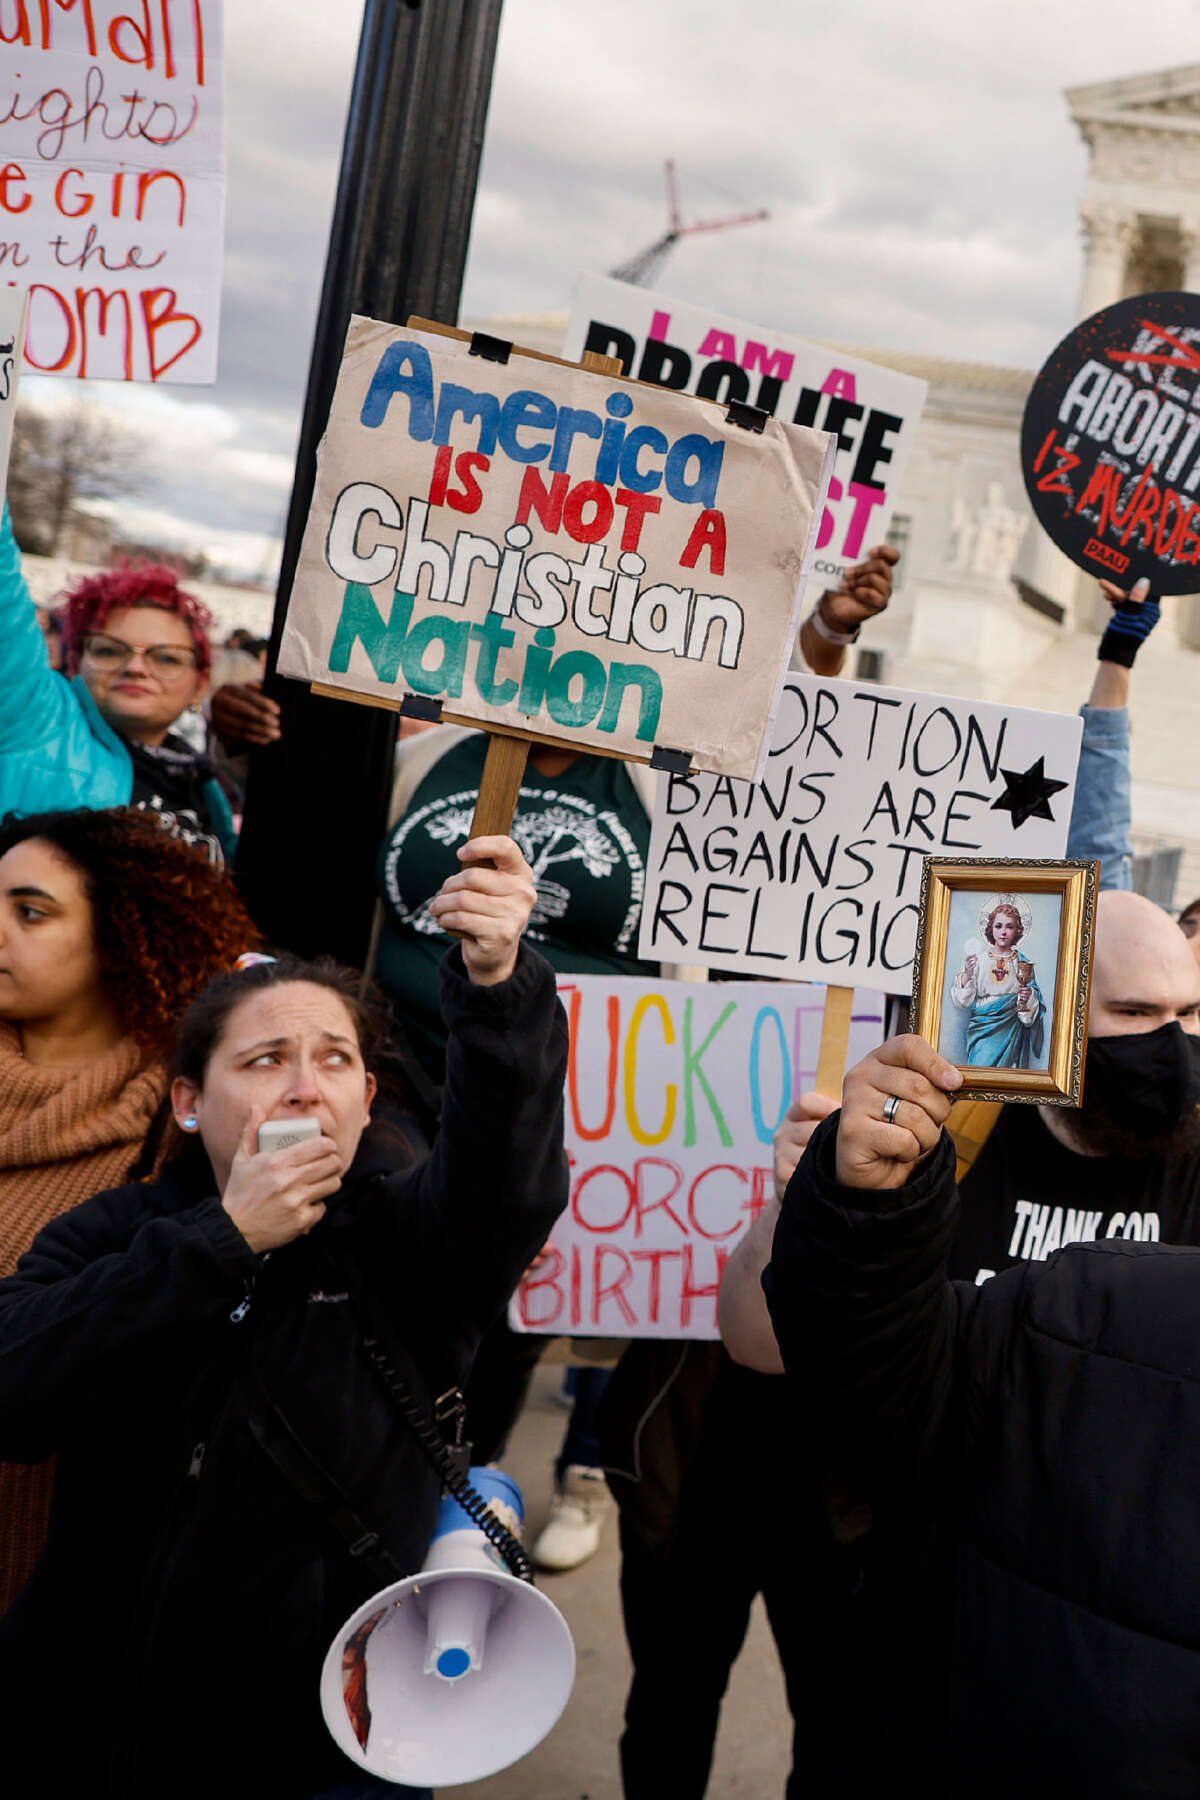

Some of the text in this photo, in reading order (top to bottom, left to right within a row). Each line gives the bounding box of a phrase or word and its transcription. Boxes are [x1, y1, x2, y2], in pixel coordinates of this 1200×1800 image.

[0, 66, 198, 160] ights
[49, 224, 167, 271] the
[24, 284, 202, 383] OMB
[697, 328, 796, 382] AM
[820, 368, 857, 404] A
[360, 340, 727, 509] America
[428, 446, 727, 576] IS NOT A
[326, 482, 745, 670] Christian
[328, 582, 664, 743] Nation
[768, 685, 1007, 783] ORTION
[666, 766, 992, 849] BANS ARE
[659, 822, 932, 897] AGAINST
[651, 880, 920, 970] RELIGIO
[558, 984, 739, 1147] UCK
[1008, 1200, 1103, 1261] THANK
[519, 1244, 727, 1327] BIRTH
